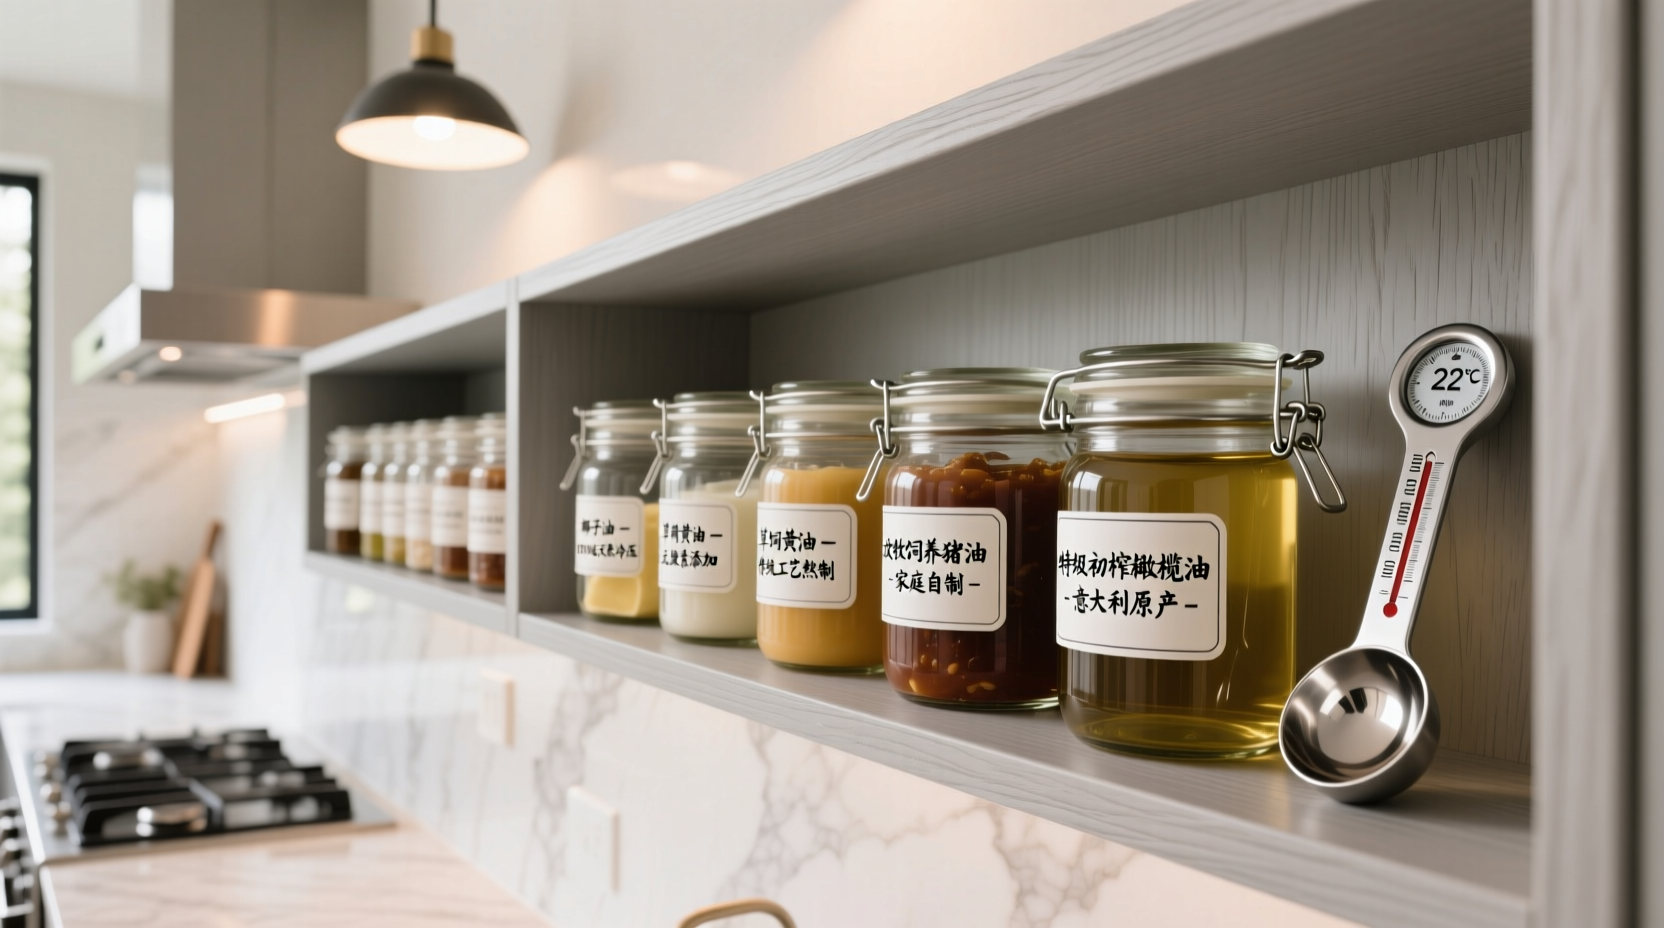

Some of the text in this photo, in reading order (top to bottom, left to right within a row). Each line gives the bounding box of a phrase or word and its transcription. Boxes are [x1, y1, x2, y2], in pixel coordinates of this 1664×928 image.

[1058, 549, 1210, 582] 特级初榨橄榄油
